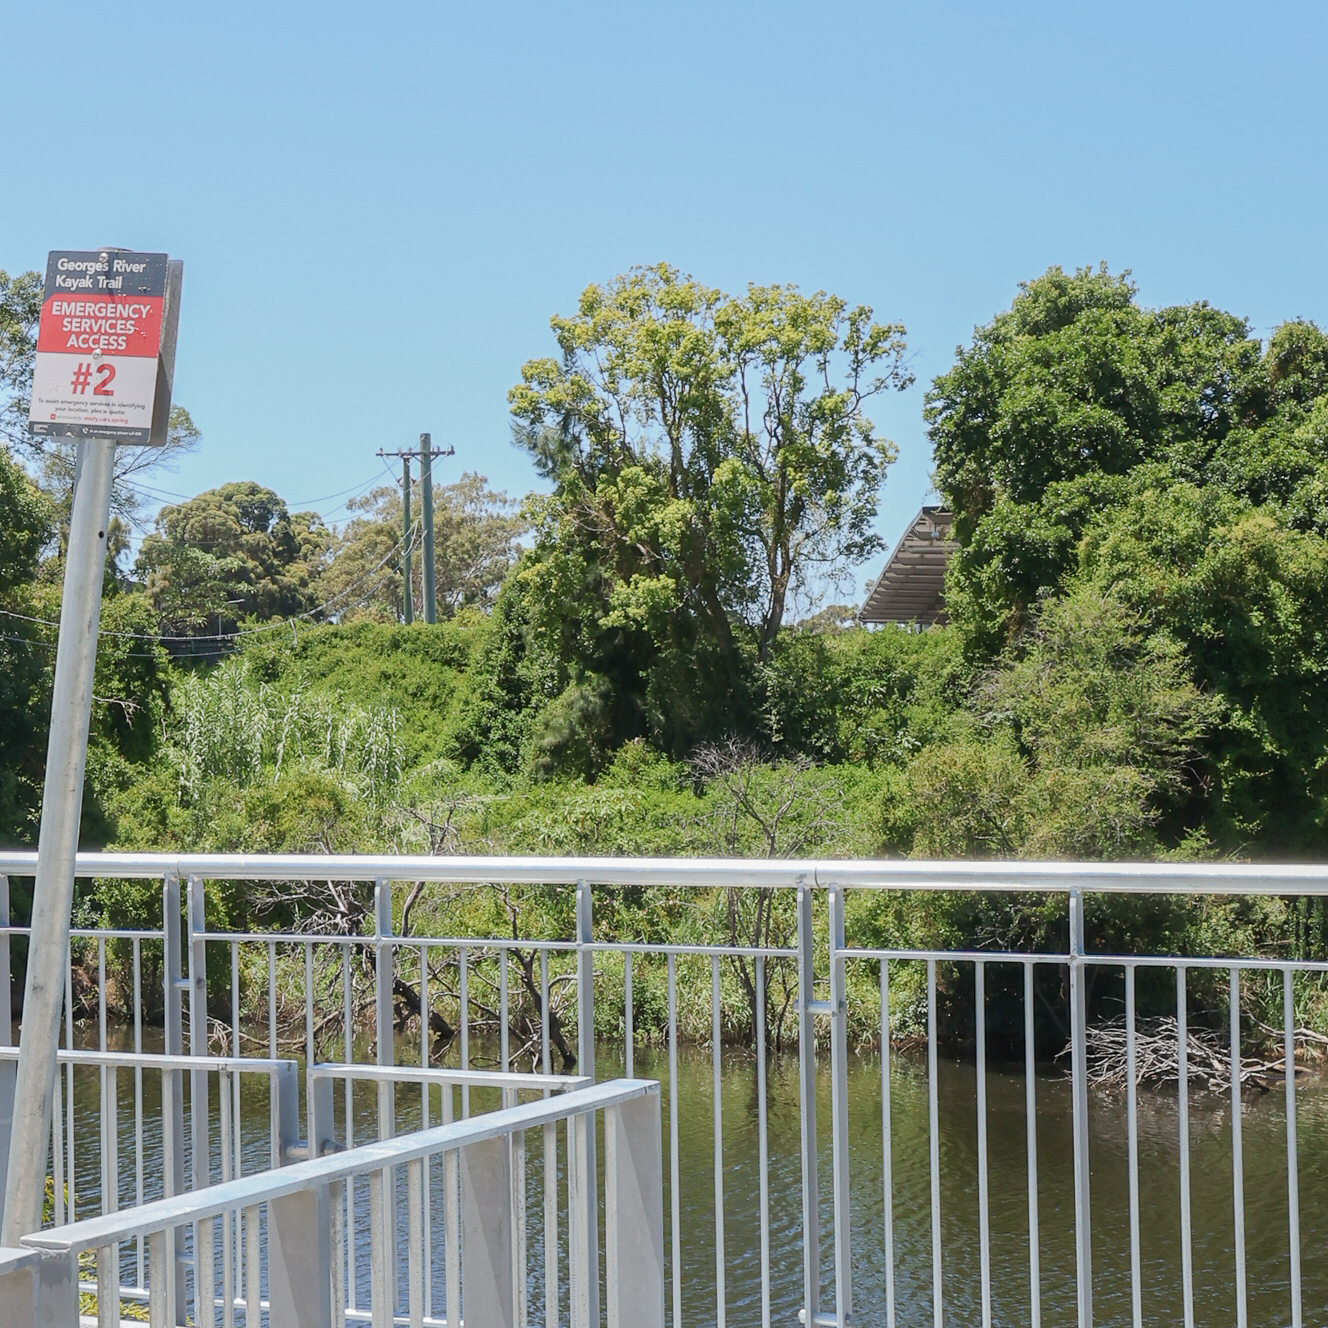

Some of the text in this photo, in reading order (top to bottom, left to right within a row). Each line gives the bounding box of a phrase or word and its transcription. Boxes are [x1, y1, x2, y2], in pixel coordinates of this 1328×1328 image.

[57, 257, 146, 274] Georges River
[55, 274, 123, 291] Kayak Trail
[52, 301, 151, 318] EMERGENCY
[62, 318, 135, 334] SERVICES
[66, 334, 127, 350] ACCESS
[71, 363, 116, 396] #2
